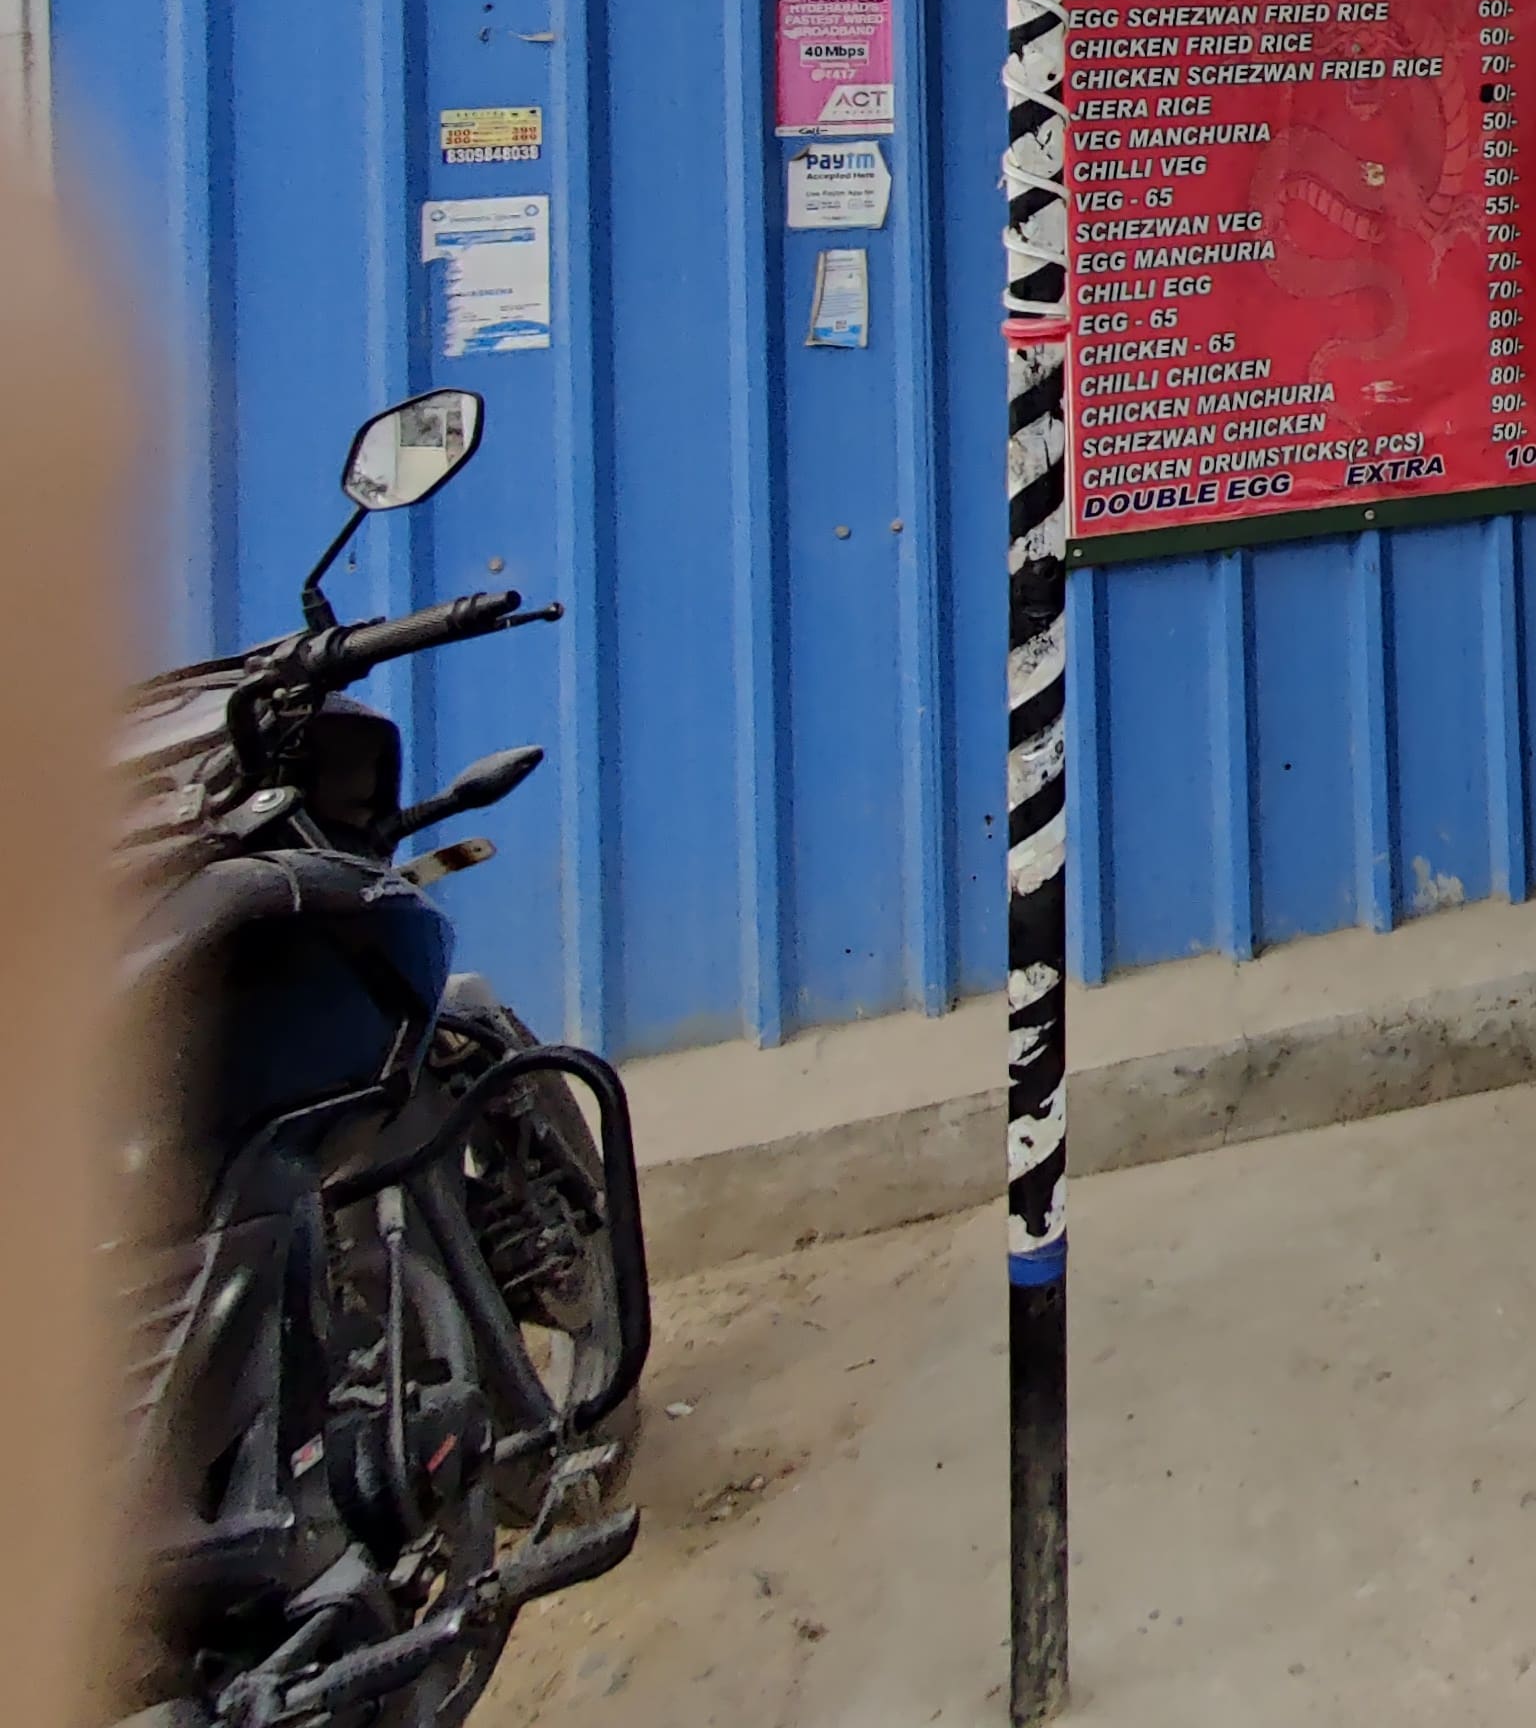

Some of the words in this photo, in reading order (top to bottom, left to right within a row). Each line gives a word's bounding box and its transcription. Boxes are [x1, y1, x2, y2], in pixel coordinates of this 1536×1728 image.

[784, 14, 840, 25] FASTEST
[843, 14, 885, 25] WIRED
[1069, 10, 1118, 28] EGG
[1127, 5, 1258, 28] SCHEZWAN
[1264, 4, 1330, 24] FRIED
[1337, 2, 1389, 22] RICE
[1478, 0, 1514, 18] 60/-
[804, 45, 823, 57] 40
[825, 45, 865, 59] Mbps
[1070, 37, 1179, 60] CHICKEN
[1185, 35, 1254, 56] FRIED
[1259, 33, 1313, 53] RICE
[1071, 67, 1180, 90] CHICKEN
[1186, 62, 1315, 86] SCHEZWAN
[1321, 59, 1386, 80] FRIED
[1391, 57, 1443, 77] RICE
[1481, 55, 1516, 74] 70/-
[835, 90, 888, 107] ACT
[1072, 100, 1148, 120] JEERA
[1156, 95, 1212, 117] RICE
[1073, 129, 1122, 151] VEG
[1128, 122, 1271, 148] MANCHURIA
[1482, 111, 1518, 131] 50/-
[1073, 158, 1153, 182] CHILLI
[1160, 155, 1207, 177] VEG
[1075, 190, 1124, 213] VEG
[1145, 187, 1173, 208] 65
[1483, 168, 1520, 187] 50/-
[1075, 215, 1210, 243] SCHEZWAN
[1217, 211, 1262, 233] VEG
[1484, 196, 1520, 216] 55/-
[1075, 251, 1127, 274] EGG
[1133, 240, 1276, 269] MANCHURIA
[1486, 224, 1521, 243] 70/-
[1077, 279, 1156, 305] CHILLI
[1162, 275, 1212, 298] EGG
[1077, 312, 1129, 336] EGG
[1149, 307, 1178, 329] 65
[1488, 280, 1523, 301] 70/-
[1079, 337, 1188, 366] CHICKEN
[1208, 332, 1236, 354] 65
[1488, 309, 1523, 329] 80/-
[1080, 369, 1159, 397] CHILLI
[1166, 358, 1271, 388] CHICKEN
[1081, 397, 1191, 428] CHICKEN
[1196, 382, 1335, 415] MANCHURIA
[1490, 365, 1525, 386] 80/-
[1082, 424, 1217, 459] SCHEZWAN
[1223, 412, 1326, 442] CHICKEN
[1491, 393, 1527, 414] 90/-
[1083, 457, 1193, 489] CHICKEN
[1374, 431, 1425, 455] PCS)
[1491, 421, 1528, 442] 50/-
[1084, 483, 1216, 519] DOUBLE
[1227, 473, 1291, 501] EGG
[1346, 456, 1445, 486] EXTRA
